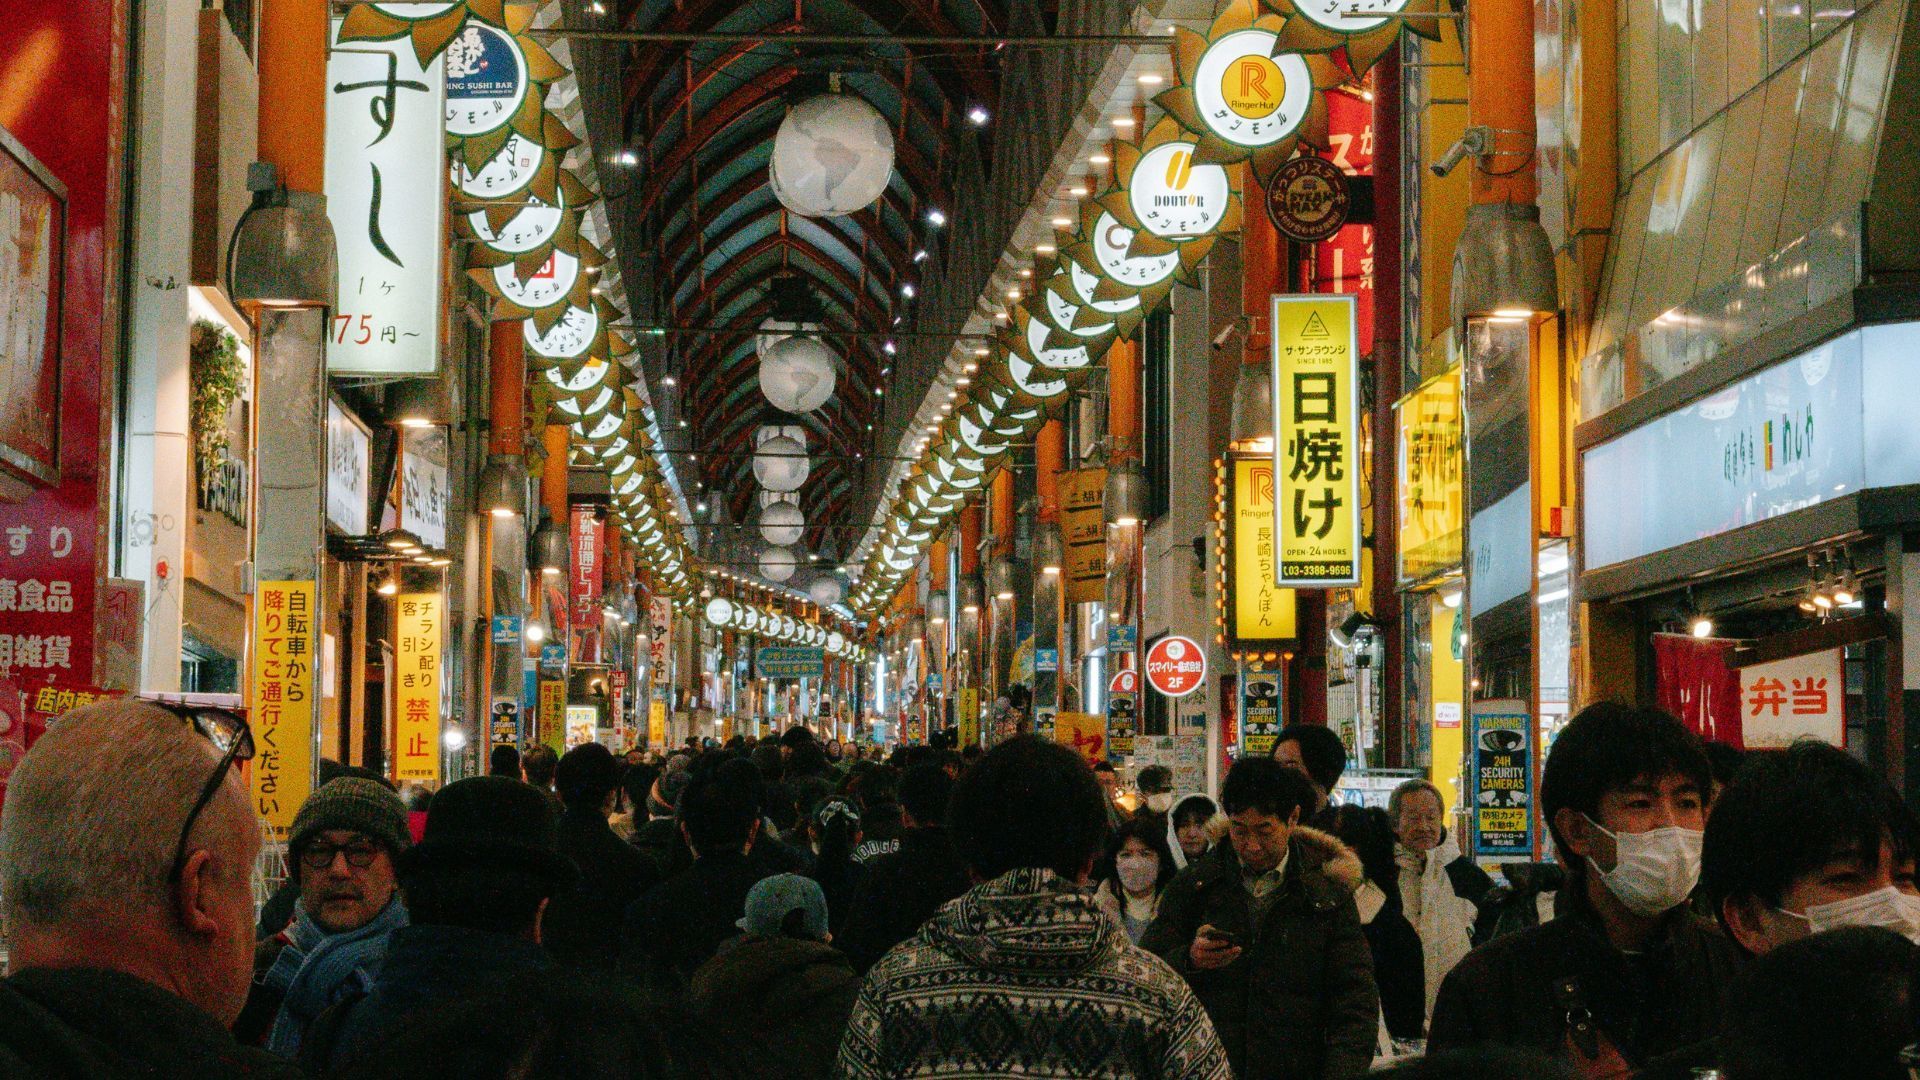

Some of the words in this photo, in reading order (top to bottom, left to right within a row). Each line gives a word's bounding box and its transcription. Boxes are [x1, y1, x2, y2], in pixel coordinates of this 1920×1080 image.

[467, 81, 493, 89] SUSHI
[495, 81, 513, 89] BAR
[1231, 100, 1258, 110] Ringer
[1259, 101, 1275, 110] Hut
[1213, 109, 1288, 135] サンモール
[333, 50, 430, 269] すし
[1154, 193, 1204, 208] DOUTOR
[1146, 210, 1210, 233] サンモール
[1108, 258, 1168, 279] サンモール
[1287, 371, 1345, 540] 日焼け
[1241, 509, 1270, 519] Ringer
[1309, 546, 1321, 556] 24
[1257, 527, 1273, 627] 長崎ちゃんぽん
[1288, 565, 1351, 576] 03-3388-9696
[286, 590, 307, 702] 自転車から
[402, 601, 418, 689] 客引き
[419, 601, 434, 688] チラシ配り
[1167, 677, 1184, 689] 2F
[259, 590, 285, 816] 降りてご通行ください
[1749, 676, 1828, 717] 弁当
[1246, 707, 1277, 715] SECURITY
[406, 698, 430, 757] 禁止
[1479, 717, 1526, 730] WARNING!
[1493, 755, 1511, 767] 24H
[1480, 767, 1524, 779] SECURITY
[1480, 778, 1525, 790] CAMERAS
[1482, 811, 1523, 820] 防犯カメラ
